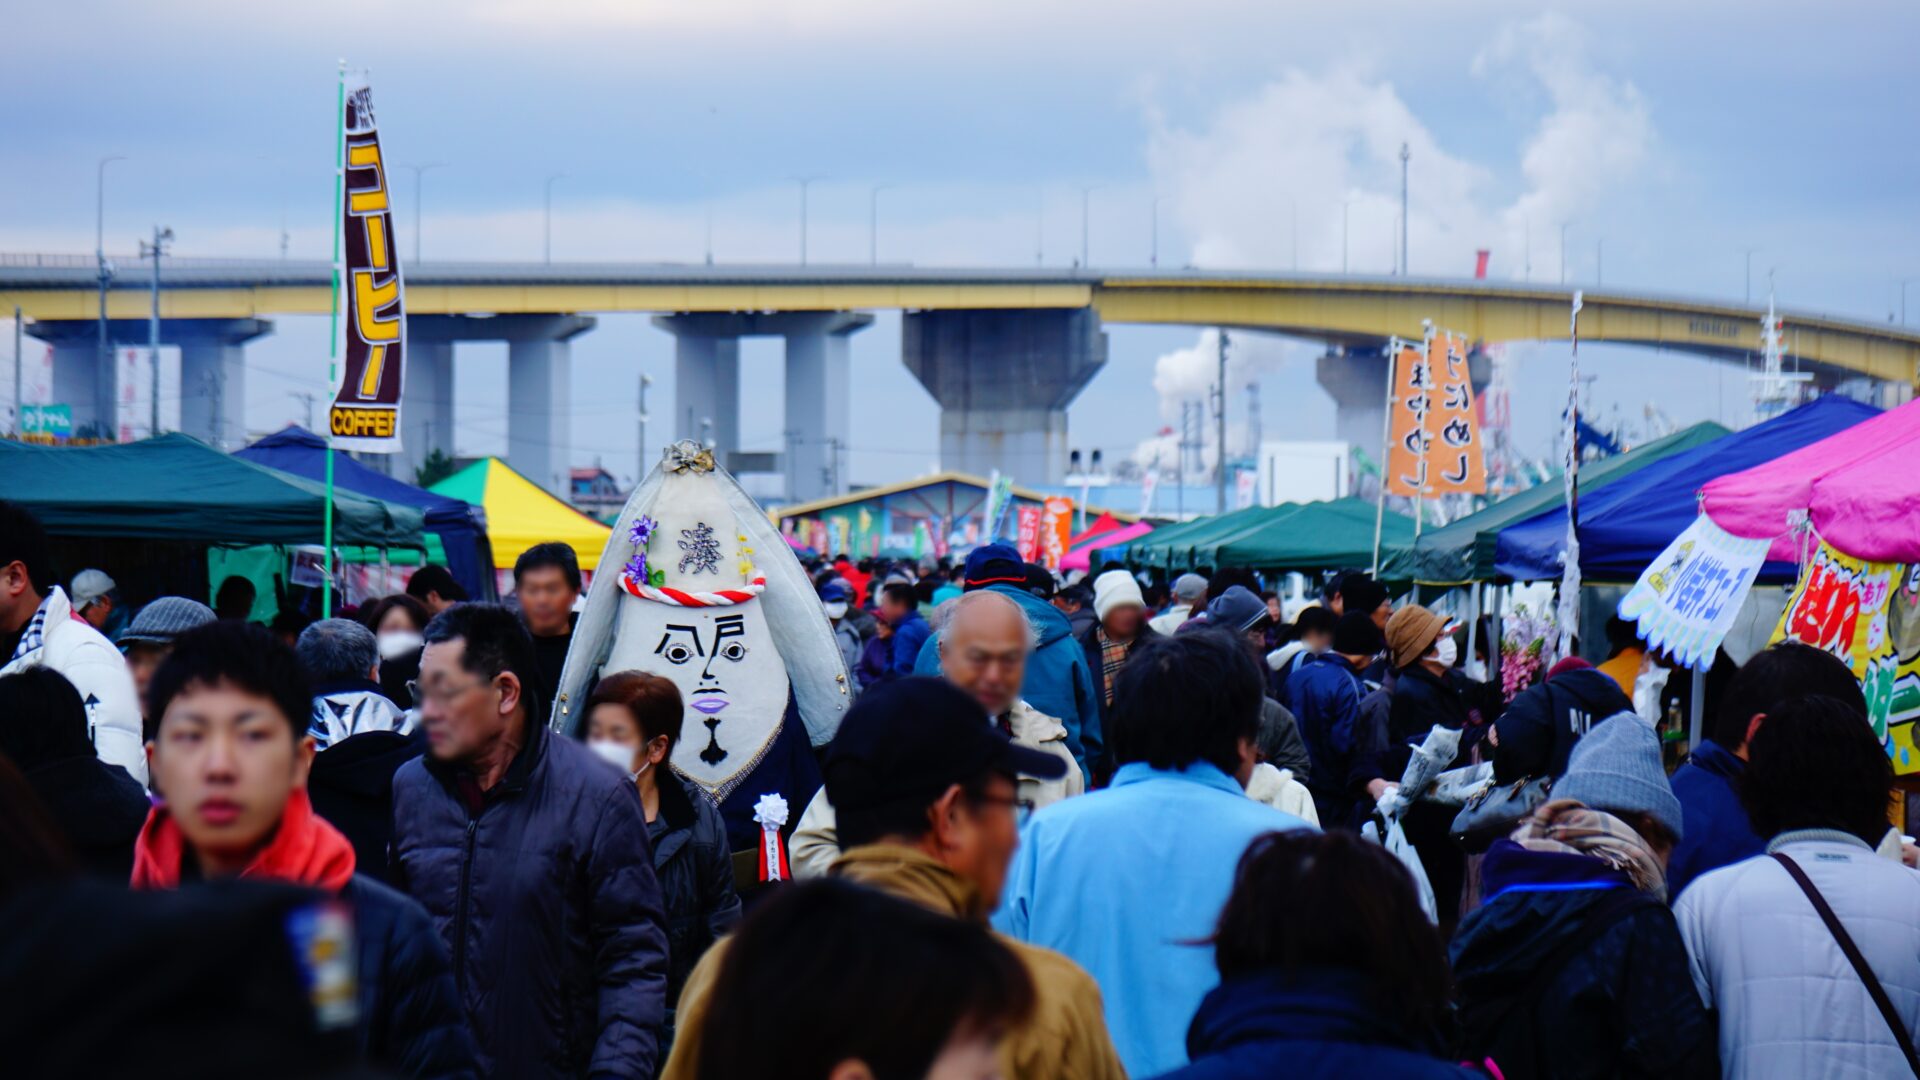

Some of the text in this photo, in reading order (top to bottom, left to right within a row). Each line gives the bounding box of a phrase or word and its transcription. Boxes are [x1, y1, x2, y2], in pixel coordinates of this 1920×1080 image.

[349, 143, 400, 399] コーヒー
[654, 614, 744, 657] 八戸
